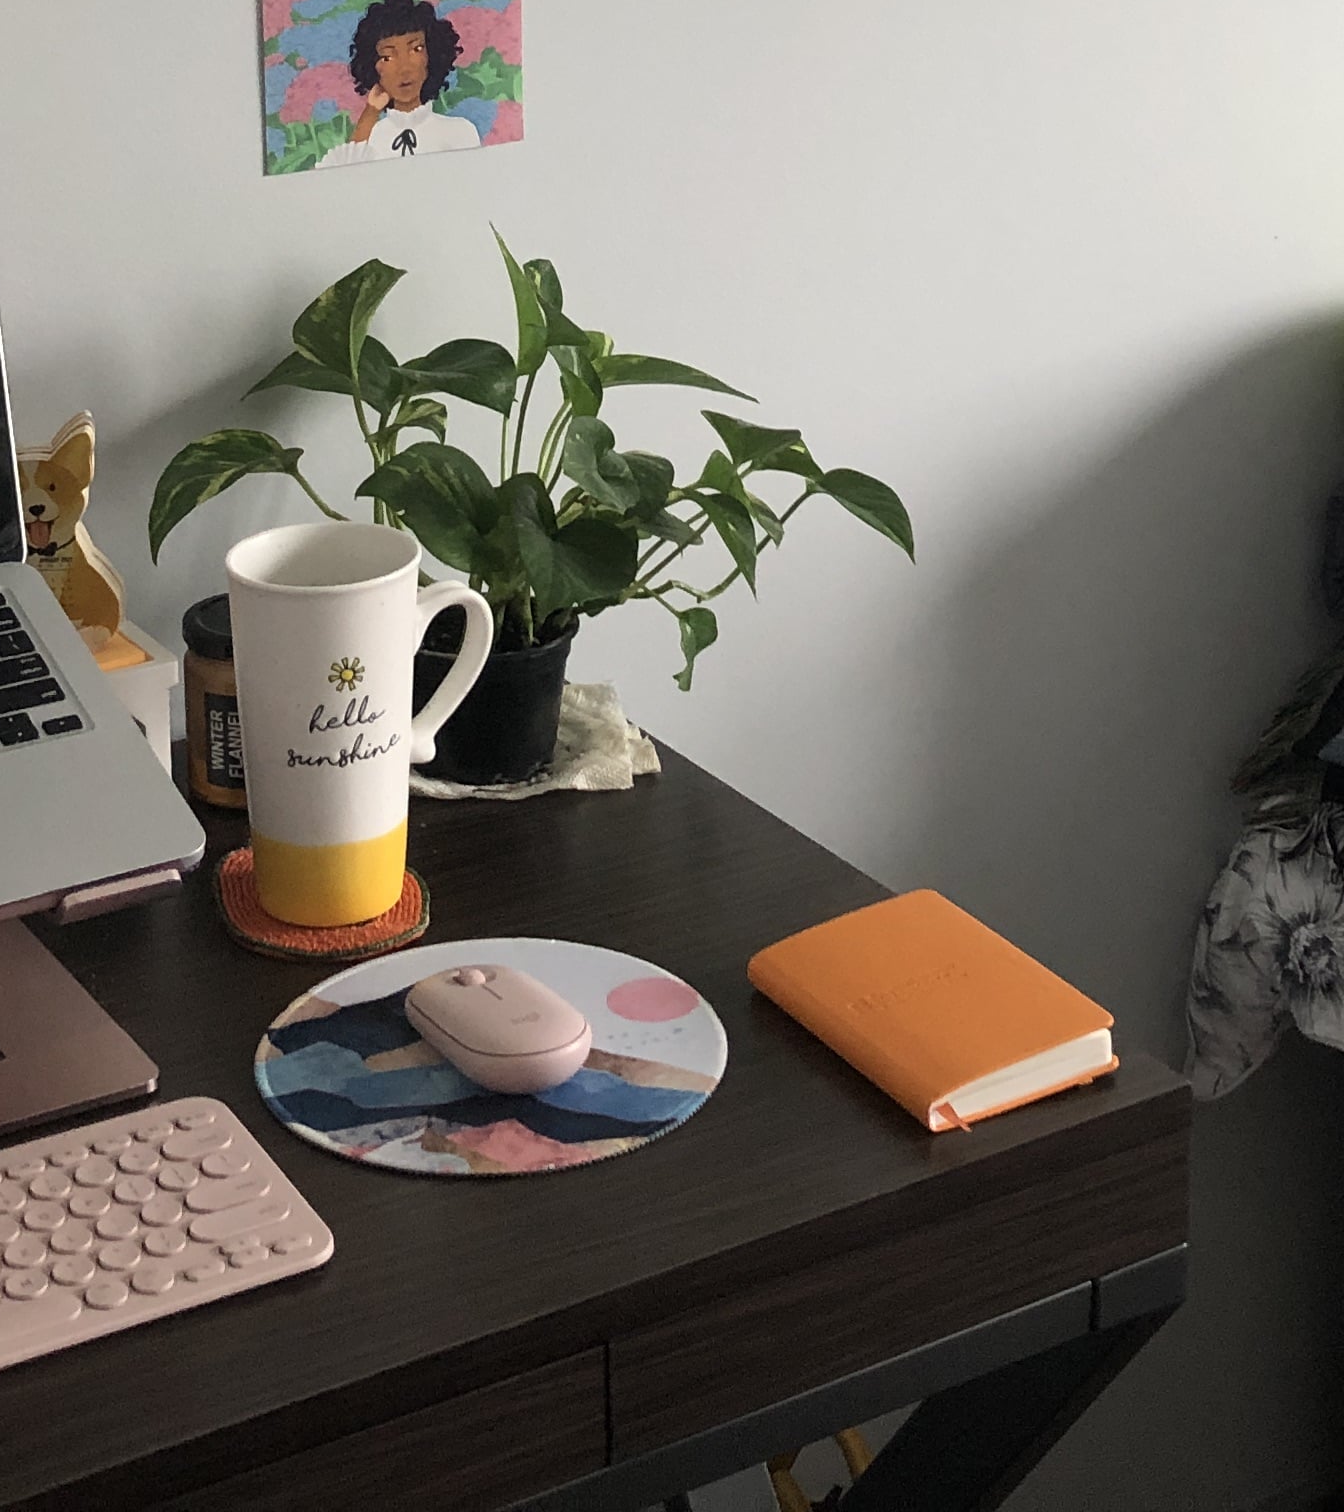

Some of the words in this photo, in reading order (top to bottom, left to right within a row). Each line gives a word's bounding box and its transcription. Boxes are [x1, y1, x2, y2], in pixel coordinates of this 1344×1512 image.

[308, 694, 387, 734] hello
[209, 709, 225, 771] WINTER
[286, 731, 402, 769] sunshine
